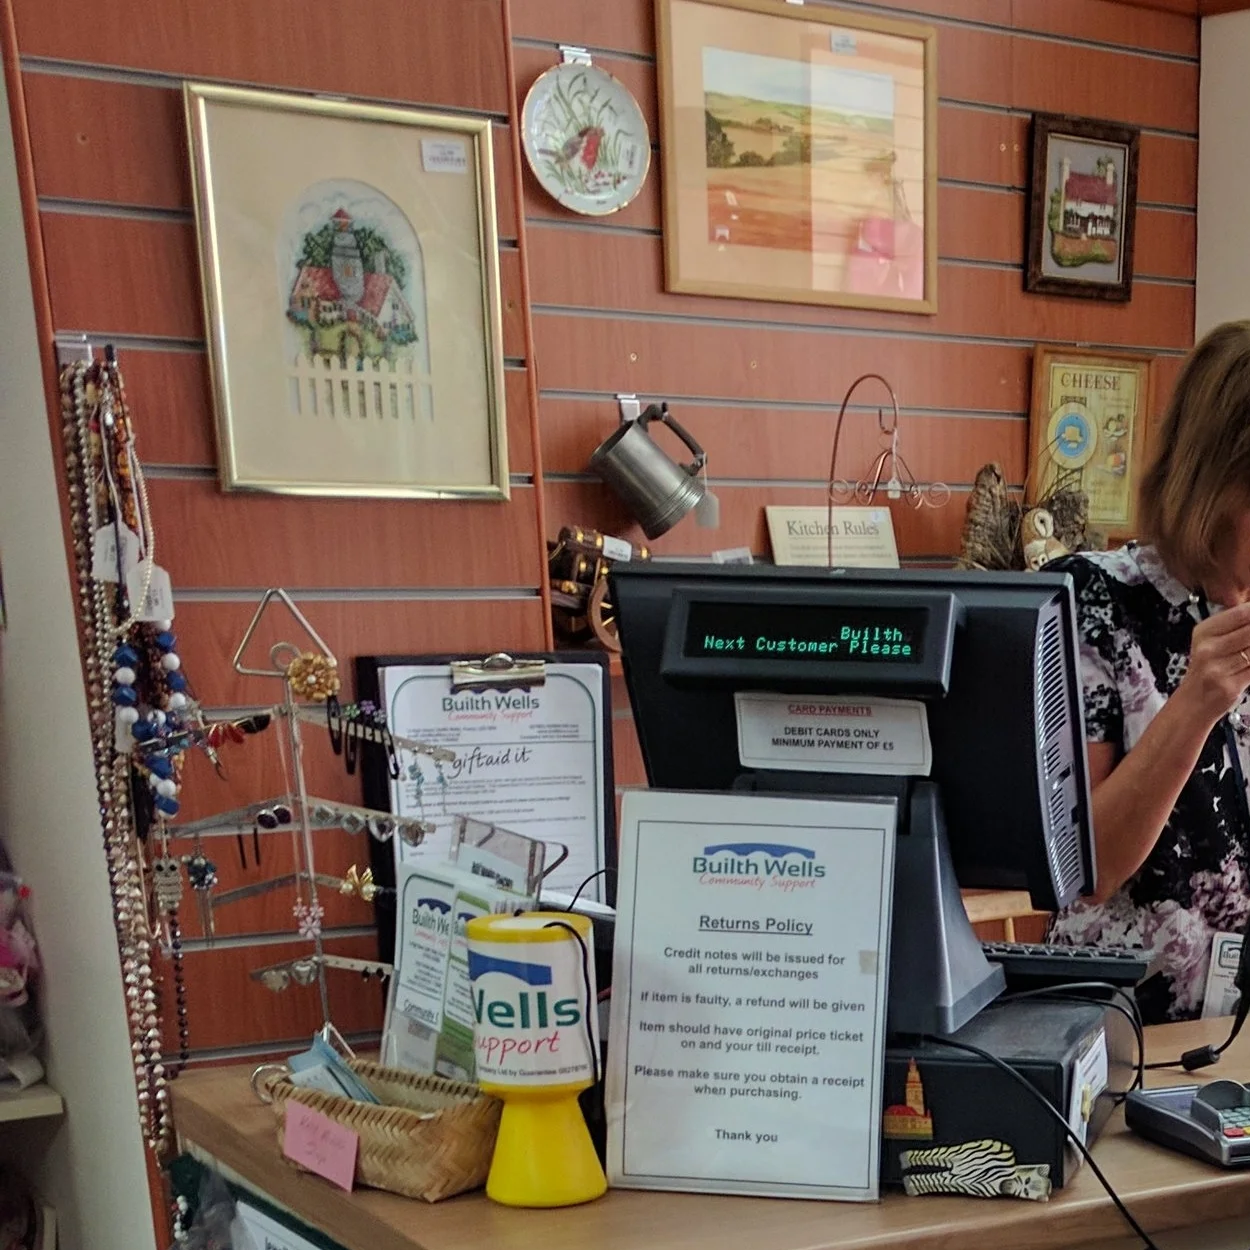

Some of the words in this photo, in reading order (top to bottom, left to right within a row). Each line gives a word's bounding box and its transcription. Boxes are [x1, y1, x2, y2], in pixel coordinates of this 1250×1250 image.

[1060, 372, 1121, 391] CHEESE
[786, 520, 839, 536] Kitchen
[842, 521, 880, 536] Rules
[841, 626, 903, 641] Builth
[704, 636, 745, 650] Next
[756, 637, 838, 653] Customer
[849, 641, 911, 655] Please
[442, 697, 492, 712] Builth
[495, 695, 540, 709] Wells
[788, 705, 817, 716] CARD
[819, 705, 873, 716] PAYMENTS
[784, 726, 813, 737] DEBIT
[816, 727, 851, 737] CARDS
[853, 729, 880, 738] ONLY
[771, 738, 815, 748] MINIMUM
[817, 739, 864, 750] PAYMENT
[866, 741, 881, 750] OF
[692, 857, 759, 875] Builth
[764, 859, 826, 878] Wells
[699, 874, 766, 890] Community
[770, 875, 816, 892] Support
[699, 915, 760, 931] Returns
[765, 917, 813, 935] Policy
[664, 947, 700, 959] Credit
[704, 950, 738, 961] notes
[741, 950, 763, 962] will
[766, 952, 781, 963] be
[784, 953, 824, 965] issued
[827, 954, 845, 965] for
[688, 963, 702, 974] all
[706, 964, 819, 981] returns/exchanges
[640, 991, 649, 1002] If
[651, 992, 678, 1003] item
[681, 993, 692, 1004] is
[695, 993, 732, 1008] faulty,
[735, 997, 742, 1006] a
[745, 996, 786, 1008] refund
[789, 998, 810, 1009] will
[813, 999, 828, 1010] be
[831, 1001, 865, 1013] given
[639, 1021, 665, 1032] Item
[668, 1022, 710, 1035] should
[714, 1024, 743, 1036] have
[746, 1026, 792, 1041] original
[795, 1029, 827, 1043] price
[830, 1030, 864, 1042] ticket
[477, 1031, 561, 1067] upport
[680, 1039, 696, 1049] on
[699, 1040, 722, 1051] and
[725, 1042, 753, 1053] your
[756, 1041, 771, 1052] till
[775, 1042, 820, 1056] receipt.
[634, 1065, 674, 1078] Please
[677, 1067, 710, 1079] make
[713, 1071, 740, 1081] sure
[743, 1073, 766, 1084] you
[770, 1073, 808, 1085] obtain
[811, 1076, 819, 1086] a
[822, 1075, 865, 1088] receipt
[694, 1084, 726, 1096] when
[730, 1087, 802, 1101] purchasing.
[715, 1129, 752, 1142] Thank
[755, 1132, 778, 1144] you
